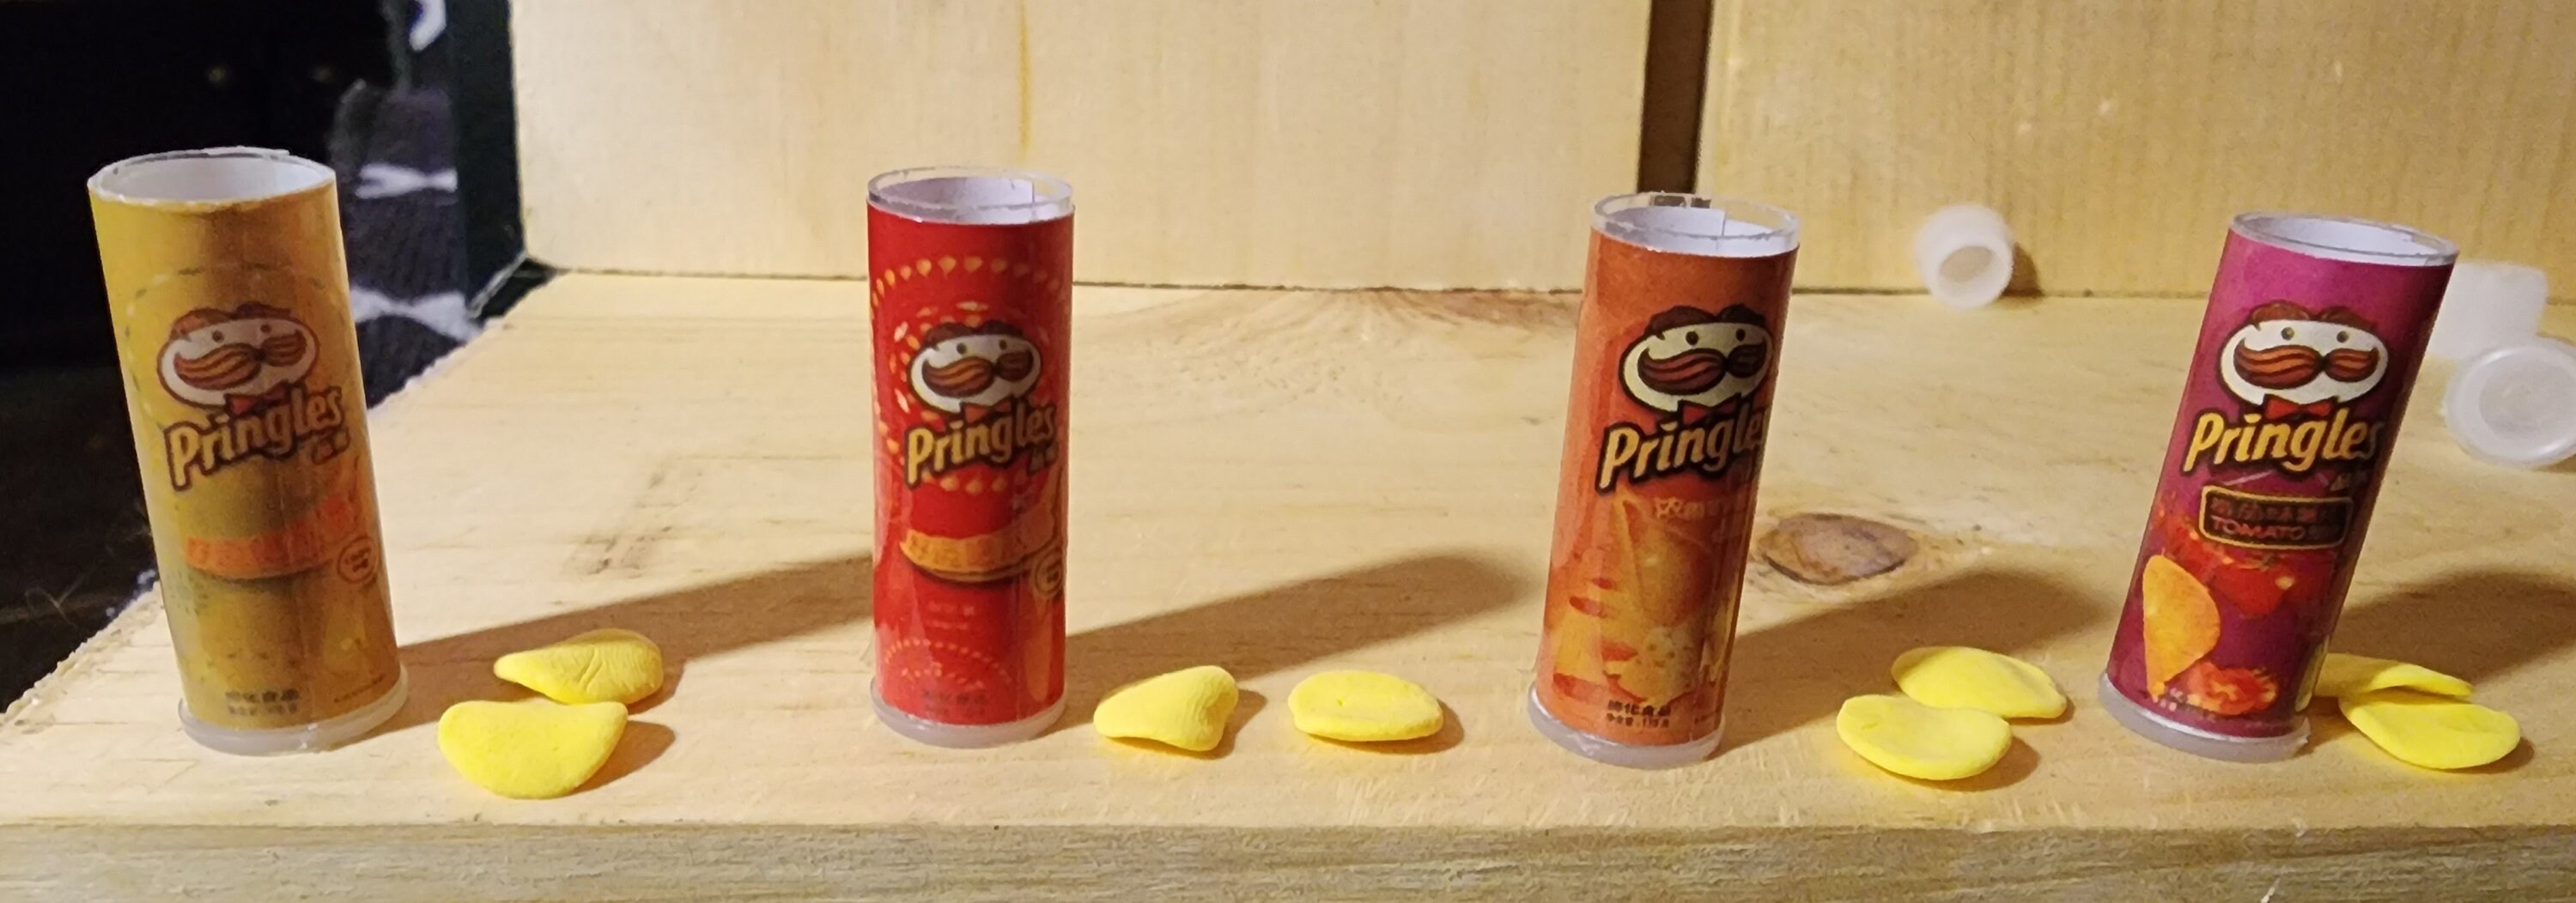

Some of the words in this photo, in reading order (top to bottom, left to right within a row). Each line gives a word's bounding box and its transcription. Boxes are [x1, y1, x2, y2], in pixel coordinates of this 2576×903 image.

[166, 384, 344, 490] Pringles
[905, 400, 1056, 488] Pringles
[1597, 400, 1765, 492] Pringle
[2182, 405, 2385, 474] Pringles
[2209, 514, 2307, 541] TOMATO
